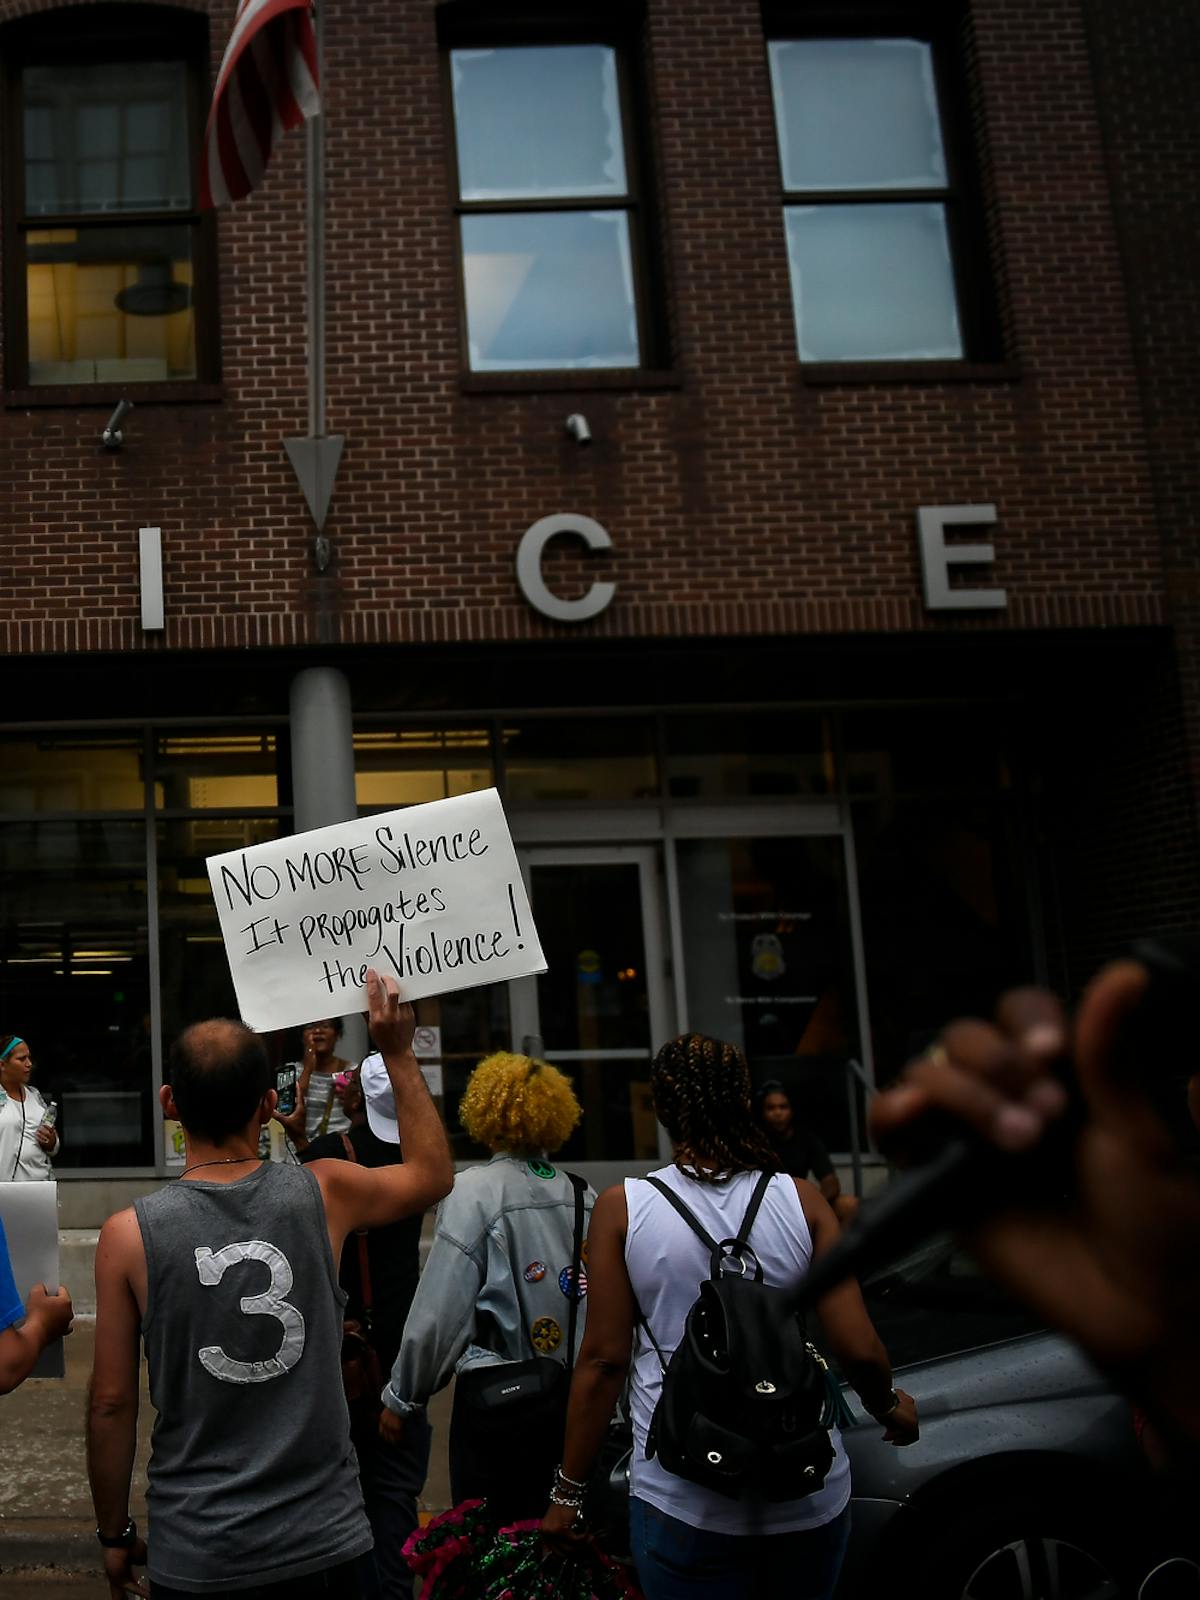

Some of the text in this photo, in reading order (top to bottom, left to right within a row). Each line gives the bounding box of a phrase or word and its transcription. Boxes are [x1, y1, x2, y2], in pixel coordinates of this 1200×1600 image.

[220, 826, 489, 910] NO MORE Silence
[240, 916, 290, 955] It
[318, 960, 368, 993] the
[194, 1240, 306, 1385] 3
